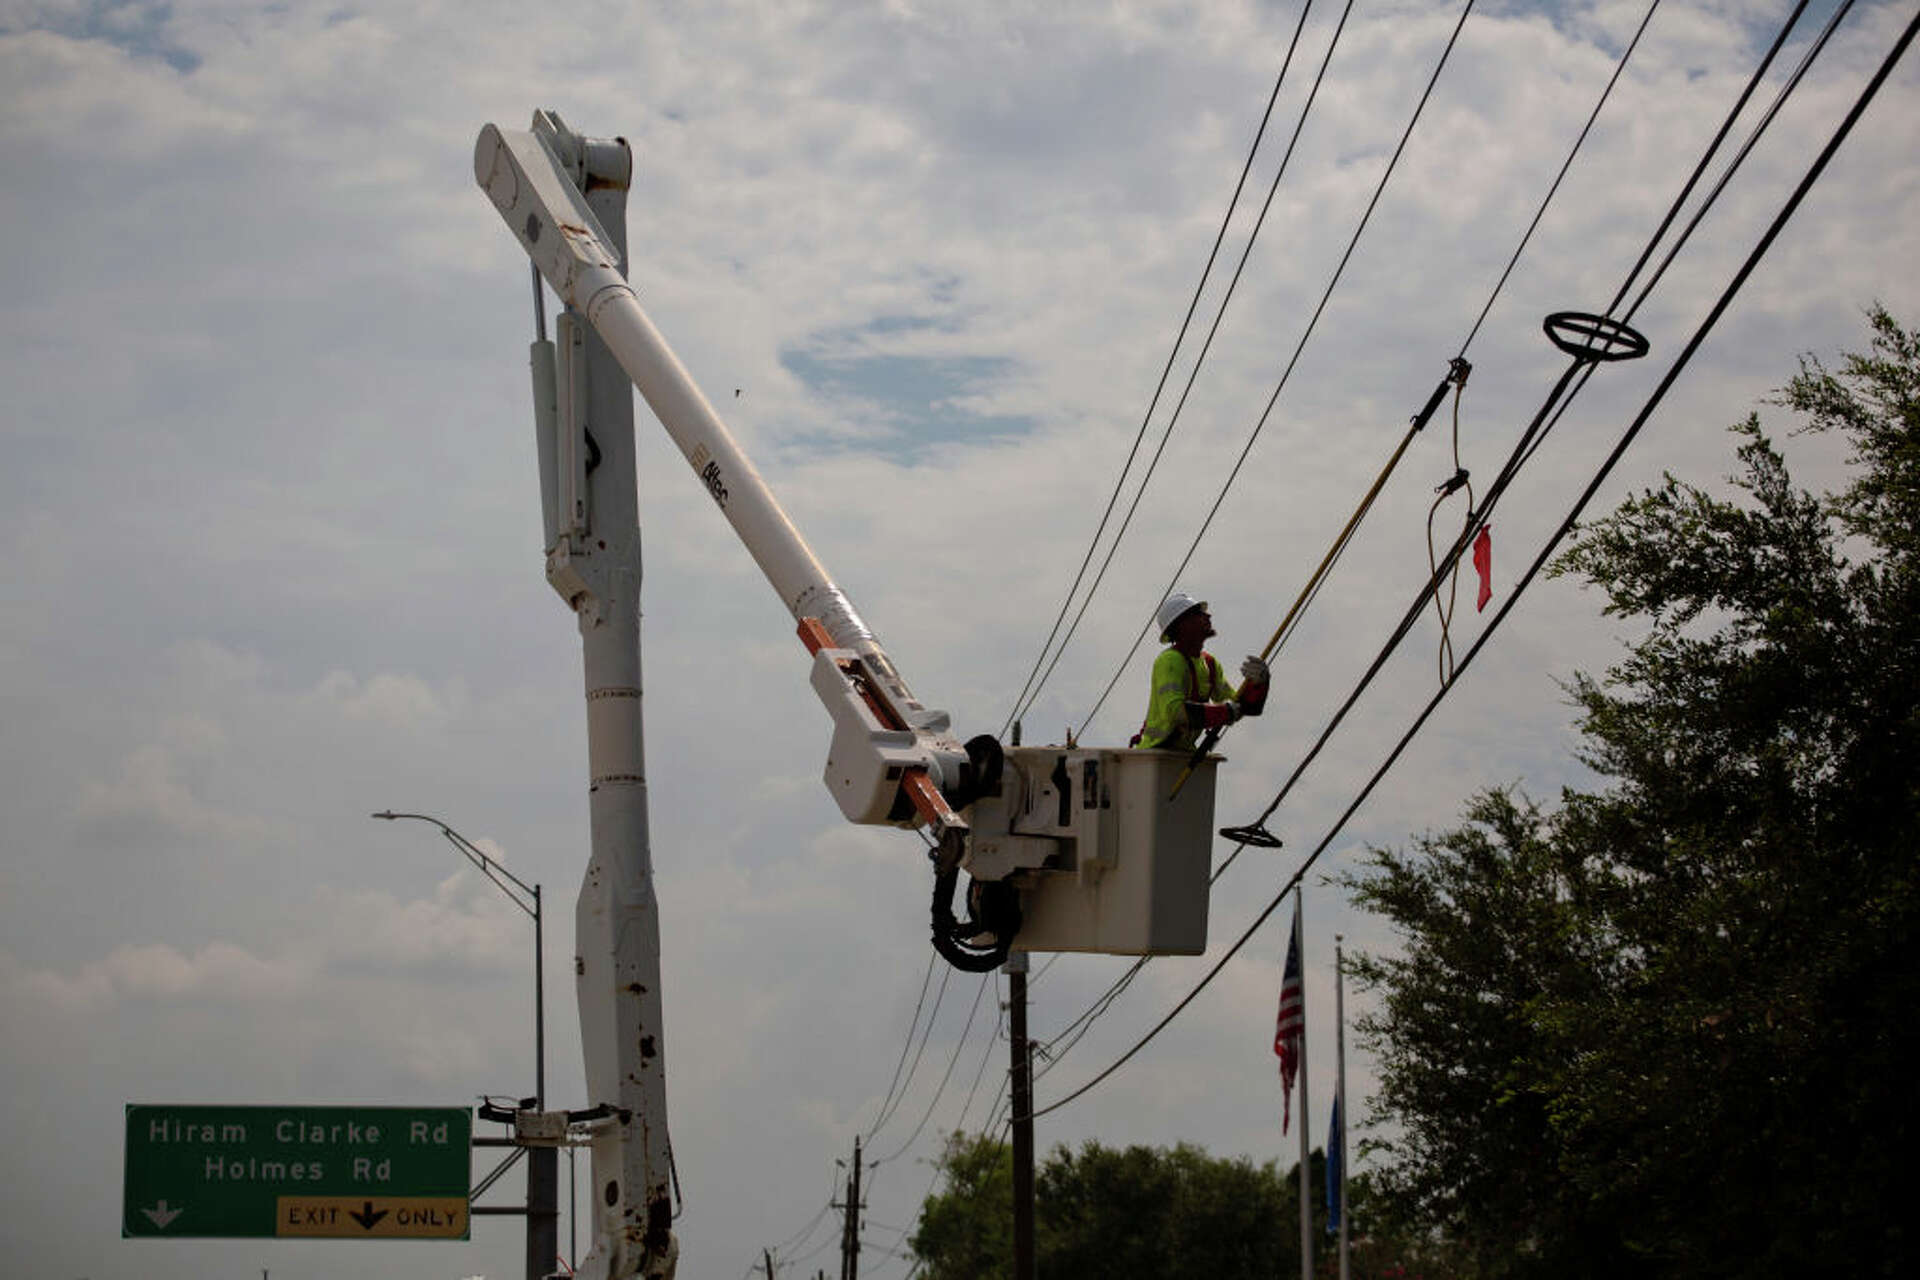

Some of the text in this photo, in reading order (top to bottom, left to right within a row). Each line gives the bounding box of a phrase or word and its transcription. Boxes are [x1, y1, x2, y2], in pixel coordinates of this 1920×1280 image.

[702, 461, 728, 508] Altec
[149, 1119, 449, 1145] Hiram Clarke Rd
[205, 1156, 391, 1181] Holmes Rd
[288, 1206, 458, 1226] EXIT ONLY
